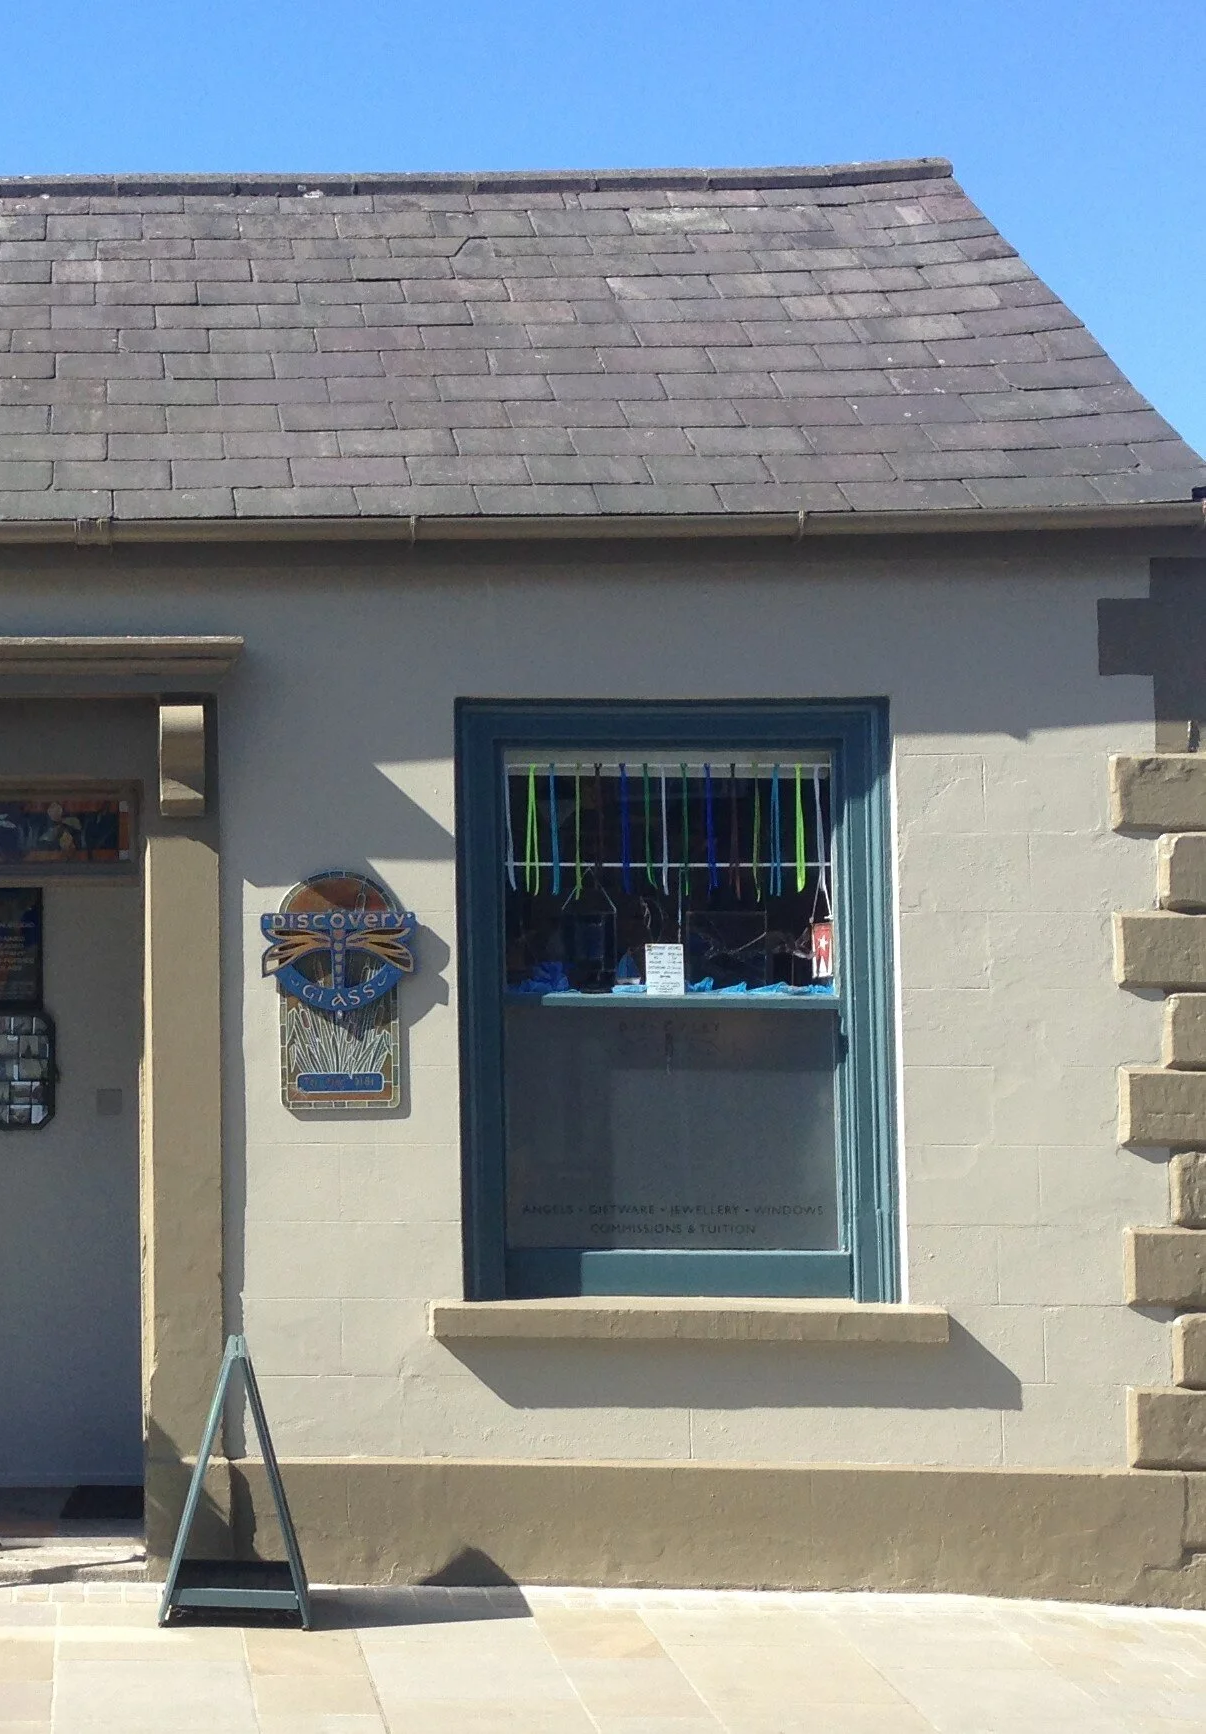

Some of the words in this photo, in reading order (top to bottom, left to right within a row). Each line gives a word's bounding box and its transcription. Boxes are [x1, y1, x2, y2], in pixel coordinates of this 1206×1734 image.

[670, 1205, 740, 1215] JEWELLERY
[754, 1205, 824, 1215] WINDOWS
[590, 1224, 683, 1235] COMMISSIONS
[700, 1224, 756, 1235] TUITION
